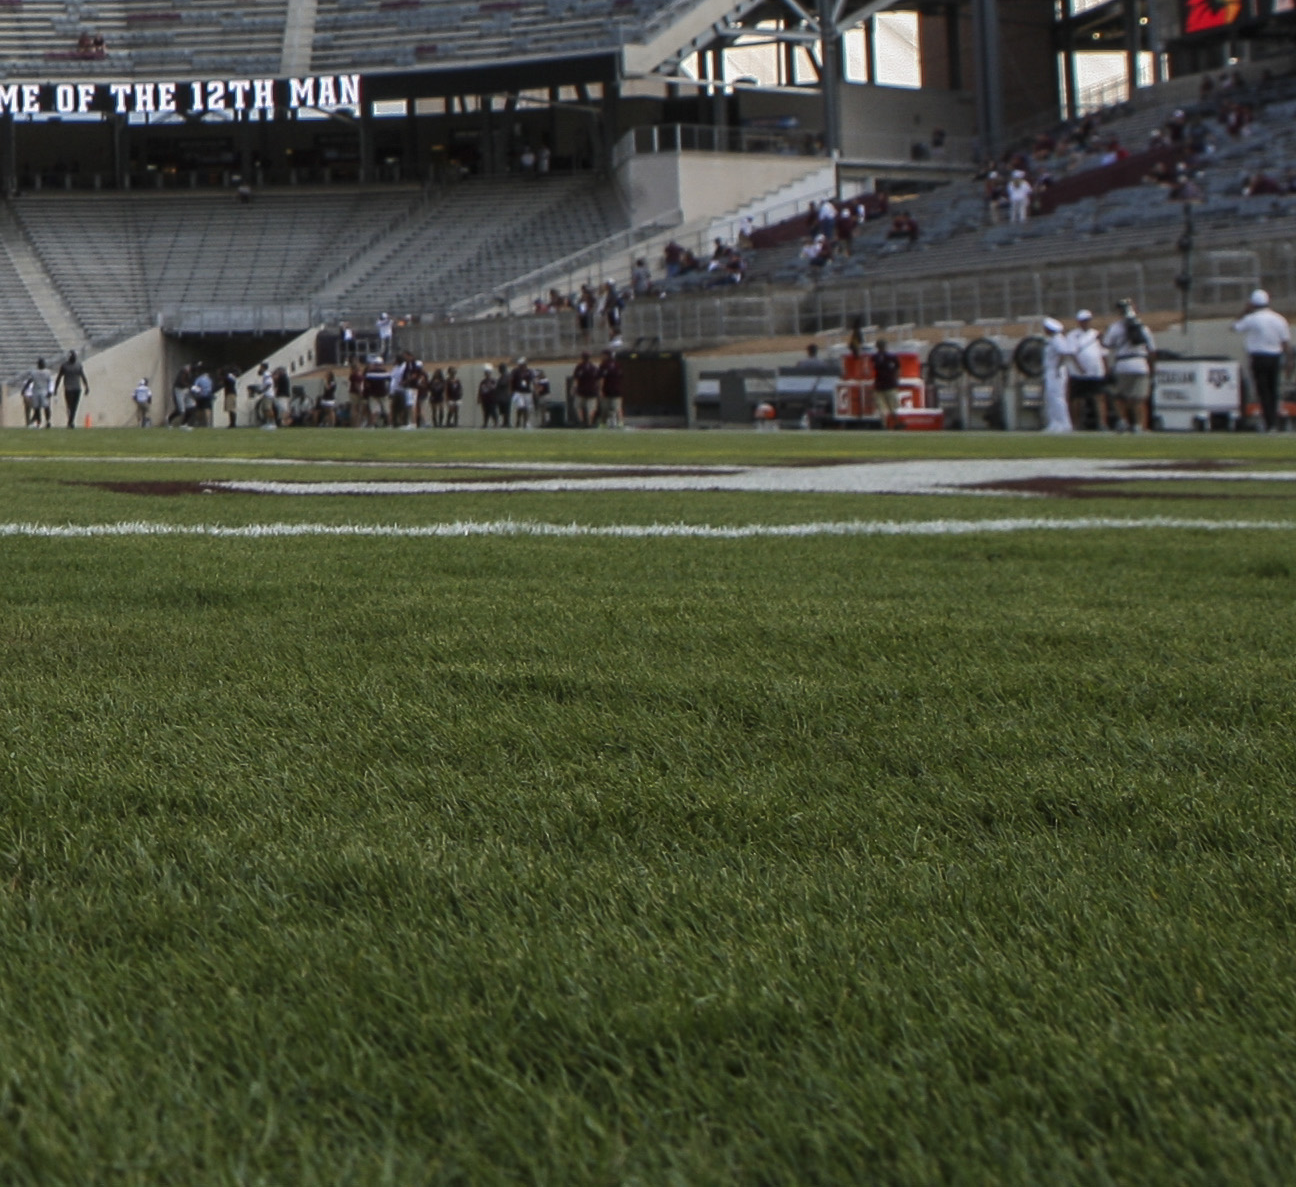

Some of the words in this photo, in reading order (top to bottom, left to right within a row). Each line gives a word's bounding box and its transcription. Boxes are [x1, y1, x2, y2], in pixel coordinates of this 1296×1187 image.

[55, 82, 96, 113] OF
[110, 81, 177, 113] THE
[191, 78, 275, 112] 12TH
[288, 73, 362, 109] MAN
